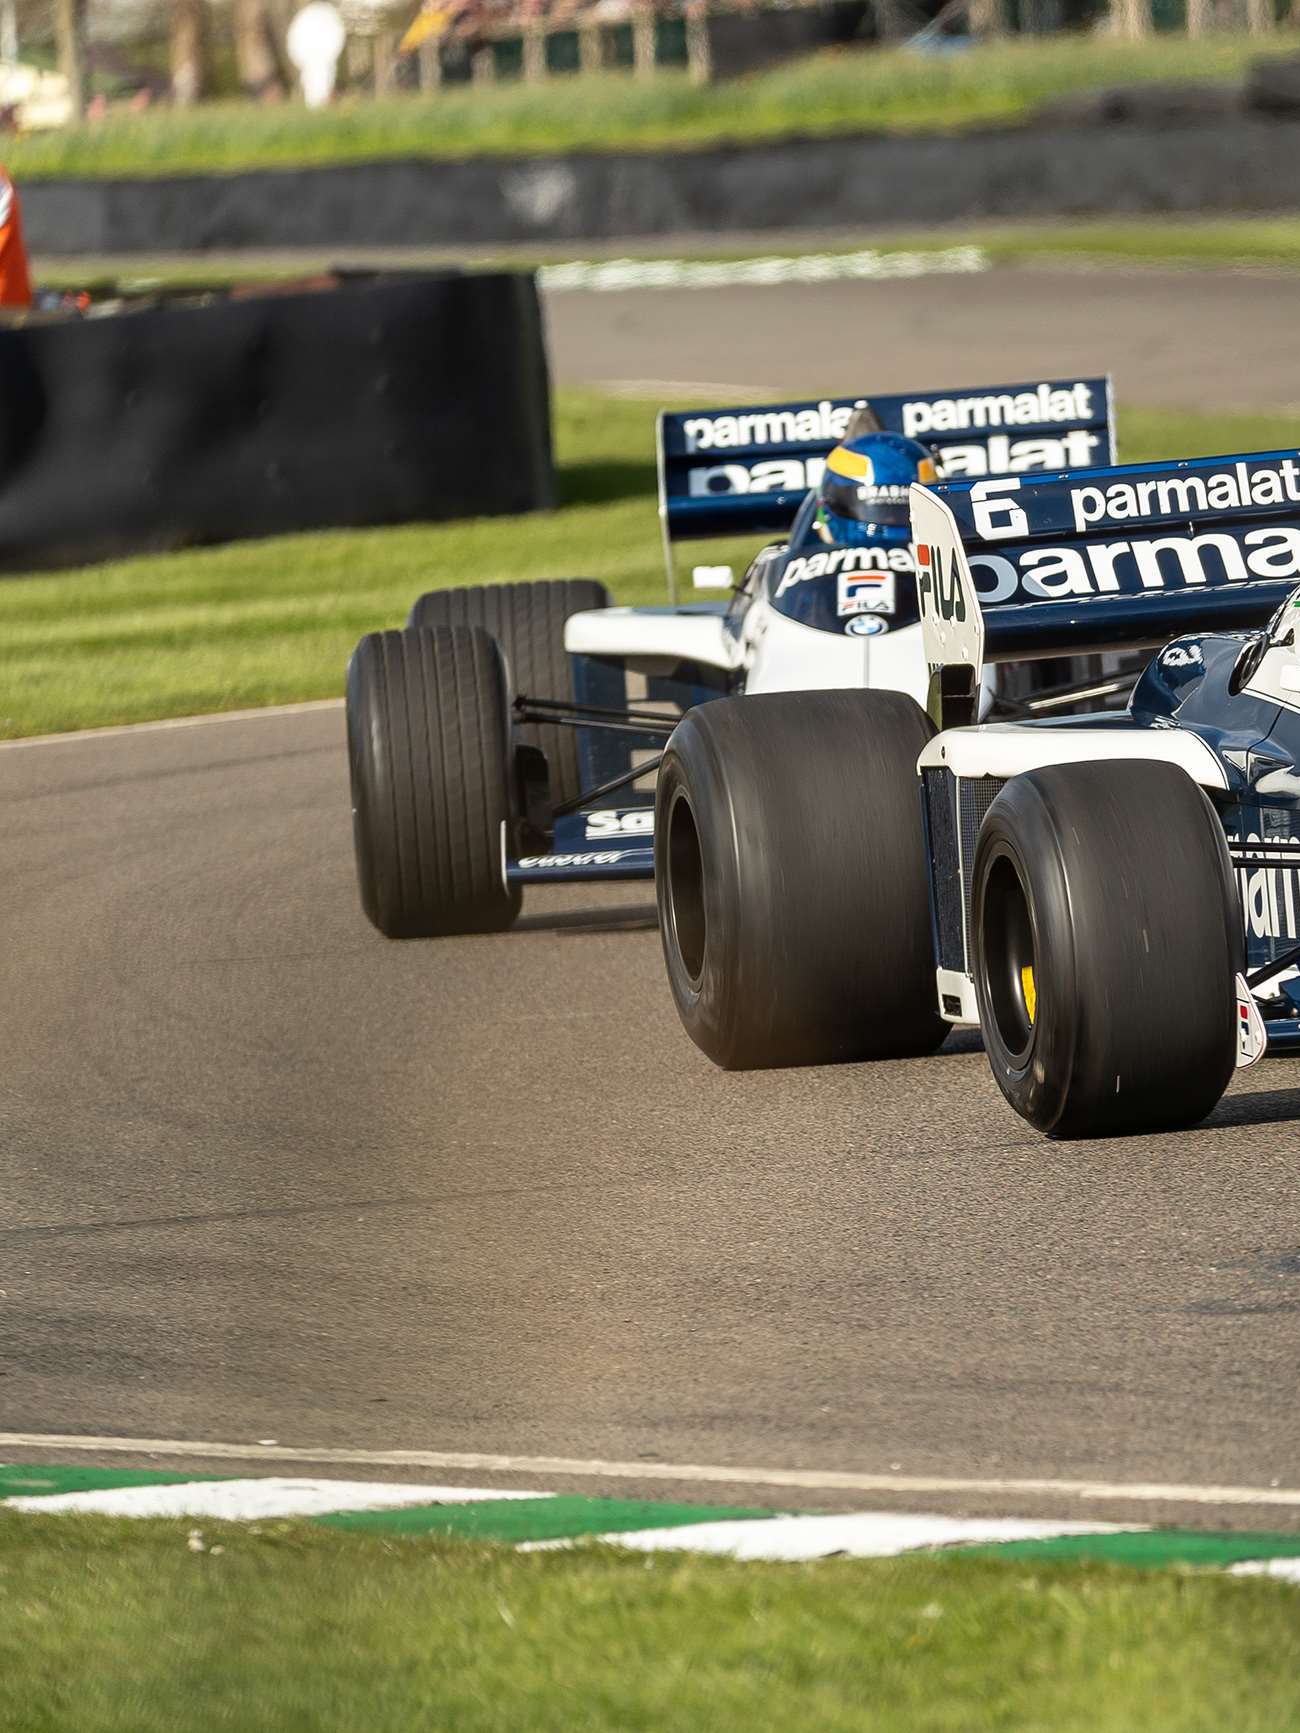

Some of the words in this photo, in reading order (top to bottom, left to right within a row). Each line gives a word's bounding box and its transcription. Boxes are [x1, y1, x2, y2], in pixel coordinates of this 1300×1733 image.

[902, 382, 1093, 438] parmalat
[969, 478, 1029, 541] 6
[774, 543, 917, 598] parma
[917, 544, 966, 622] FILA
